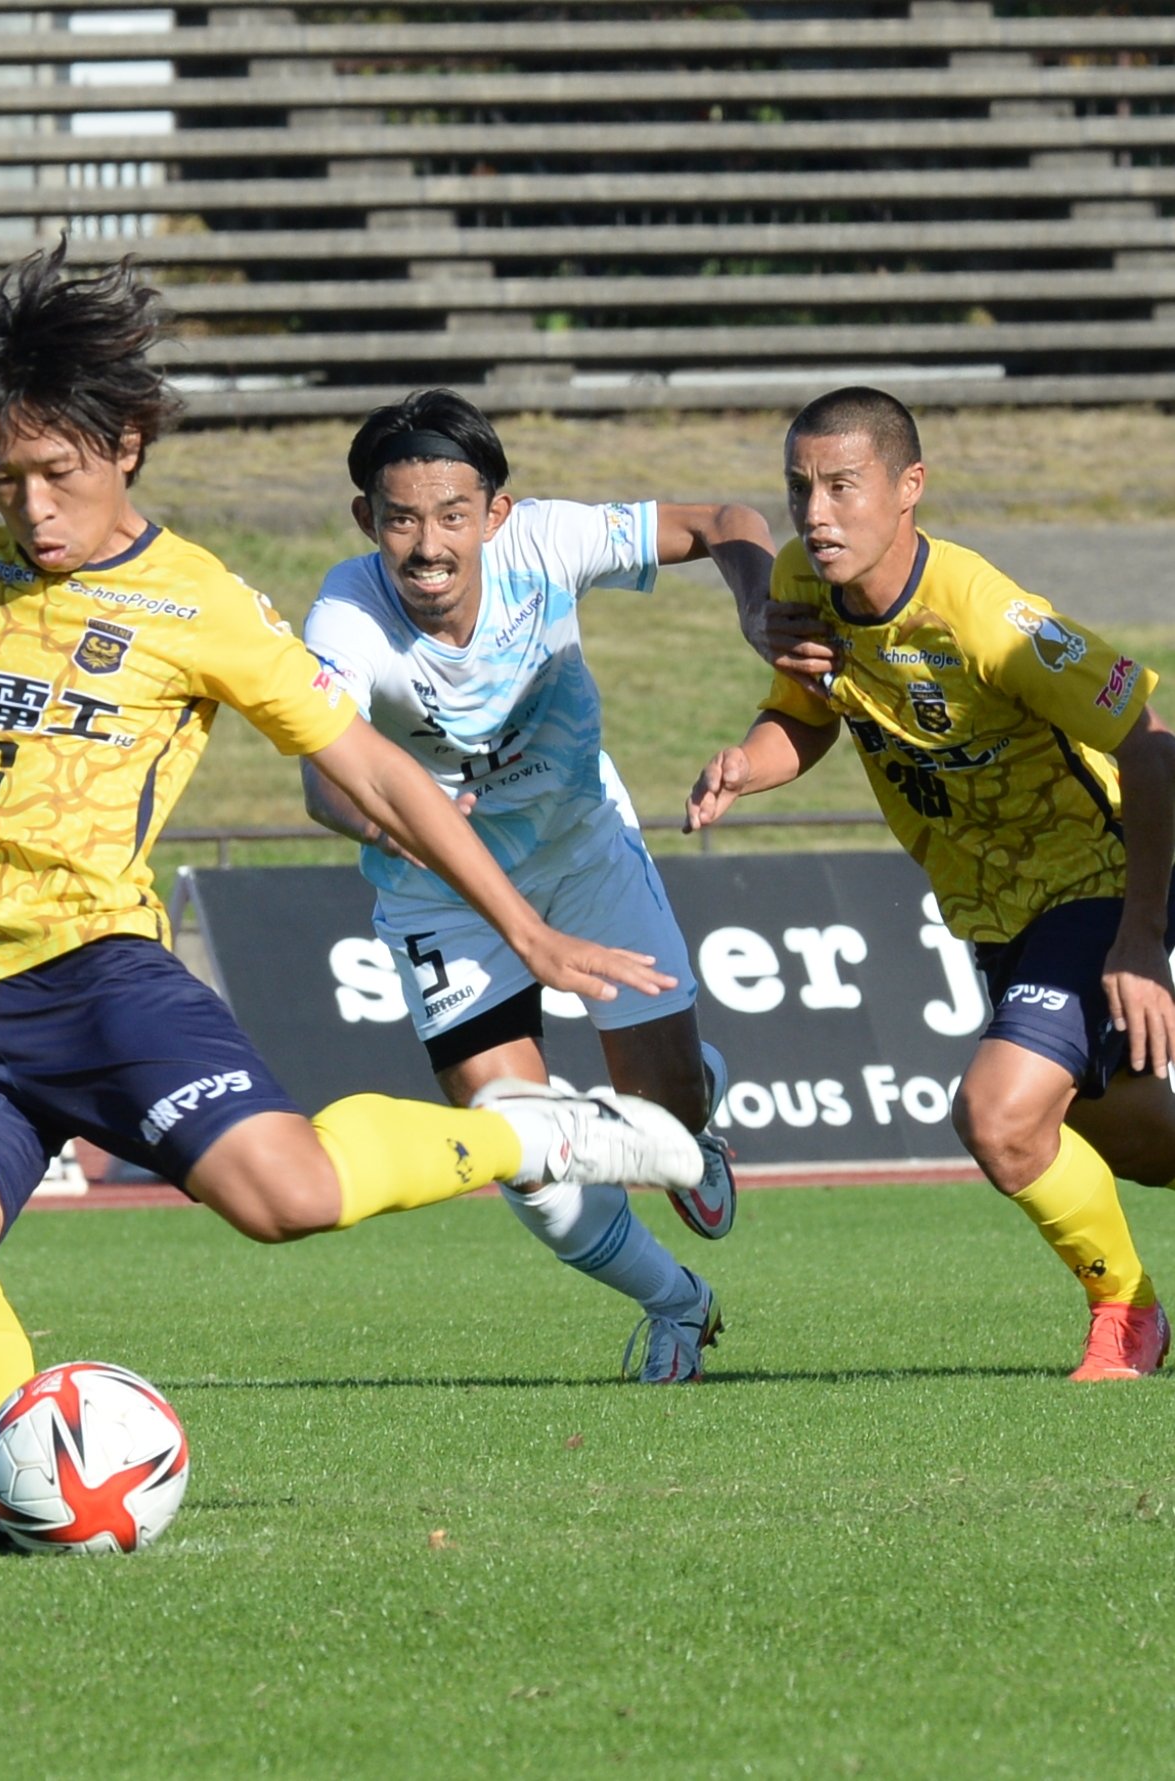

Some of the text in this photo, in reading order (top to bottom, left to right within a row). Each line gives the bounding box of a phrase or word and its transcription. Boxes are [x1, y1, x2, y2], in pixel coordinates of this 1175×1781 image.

[1094, 655, 1134, 709] TSK
[500, 760, 552, 786] TOWEL
[404, 931, 450, 1000] 5
